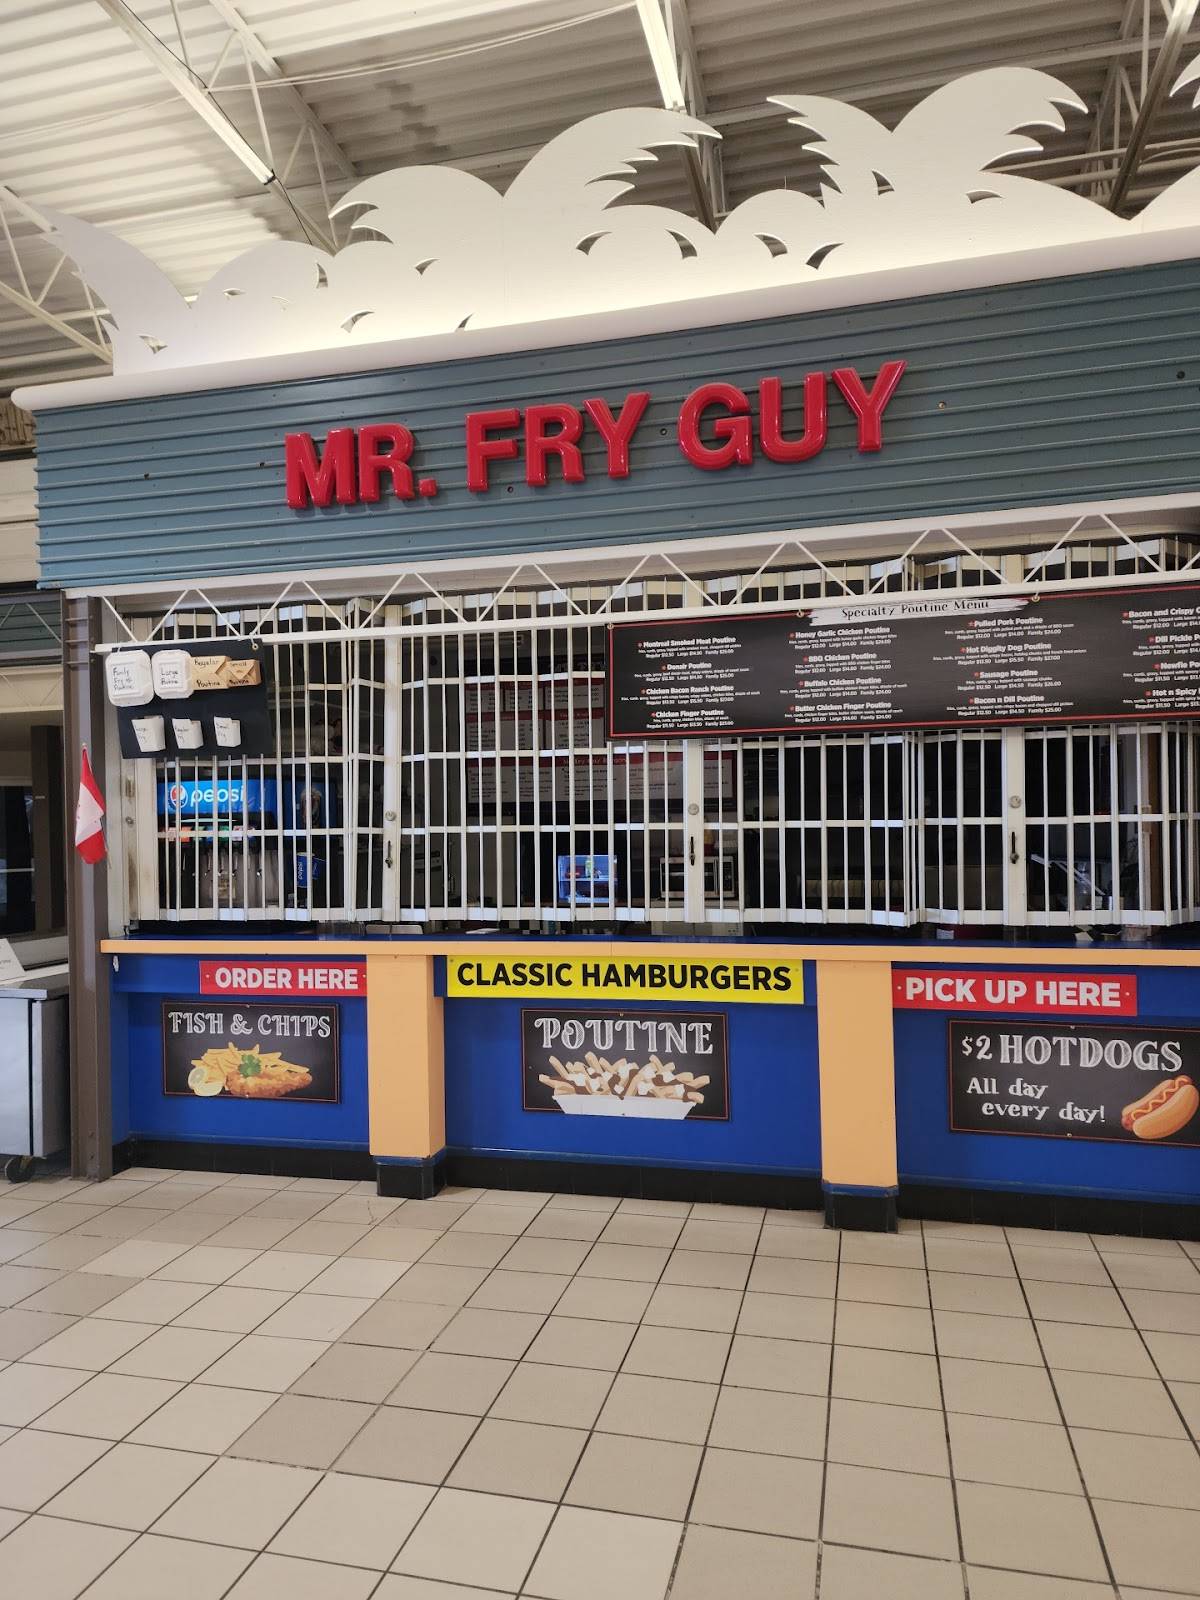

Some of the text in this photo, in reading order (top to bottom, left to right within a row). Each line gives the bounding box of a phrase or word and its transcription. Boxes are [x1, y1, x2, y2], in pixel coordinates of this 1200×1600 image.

[284, 360, 909, 509] MR. FRY GUY
[842, 599, 990, 620] Specialty Poutine Menu
[1129, 610, 1152, 618] Bacon
[1176, 688, 1197, 696] Spicy
[215, 967, 359, 990] ORDER HERE
[457, 962, 792, 991] CLASSIC HAMBURGERS
[905, 976, 1121, 1007] PICK UP HERE
[168, 1011, 331, 1038] FISH & CHIPS
[534, 1017, 713, 1054] POUTINE
[961, 1034, 1183, 1073] $2 HOTDOGS
[966, 1076, 1048, 1099] All day
[981, 1101, 1106, 1123] every day!
